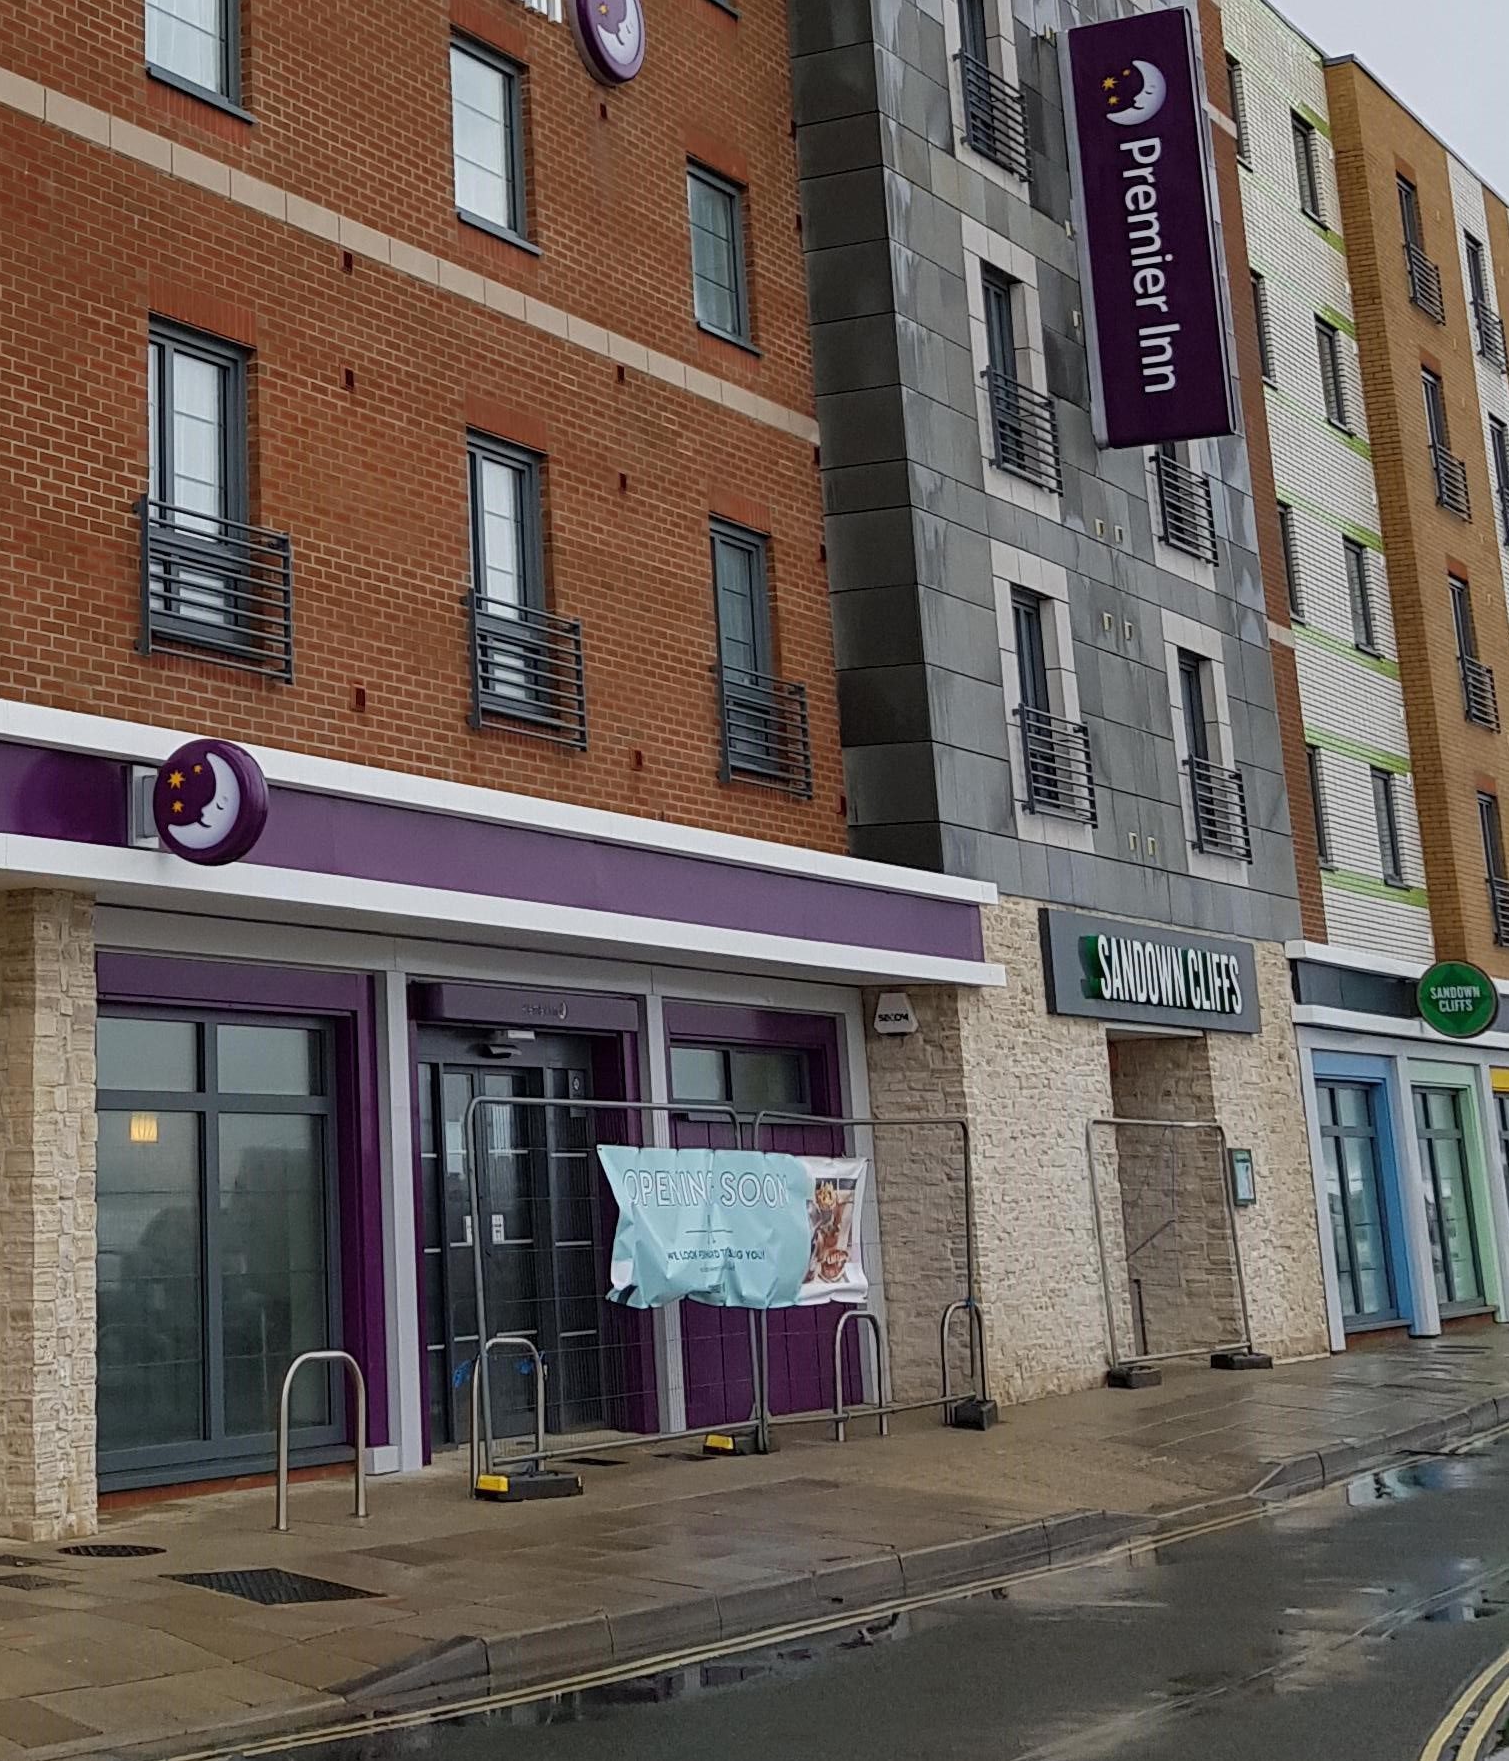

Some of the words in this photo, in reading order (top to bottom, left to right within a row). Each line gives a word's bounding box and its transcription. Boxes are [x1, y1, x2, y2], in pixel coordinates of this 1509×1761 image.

[1119, 137, 1173, 313] Premier
[1138, 323, 1181, 394] Inn
[1097, 934, 1188, 1008] SANDOWN
[1187, 948, 1243, 1015] CLIFFS
[1430, 984, 1481, 1000] SANDOWN
[1438, 999, 1474, 1013] CLIFFS
[720, 1171, 790, 1208] SOON
